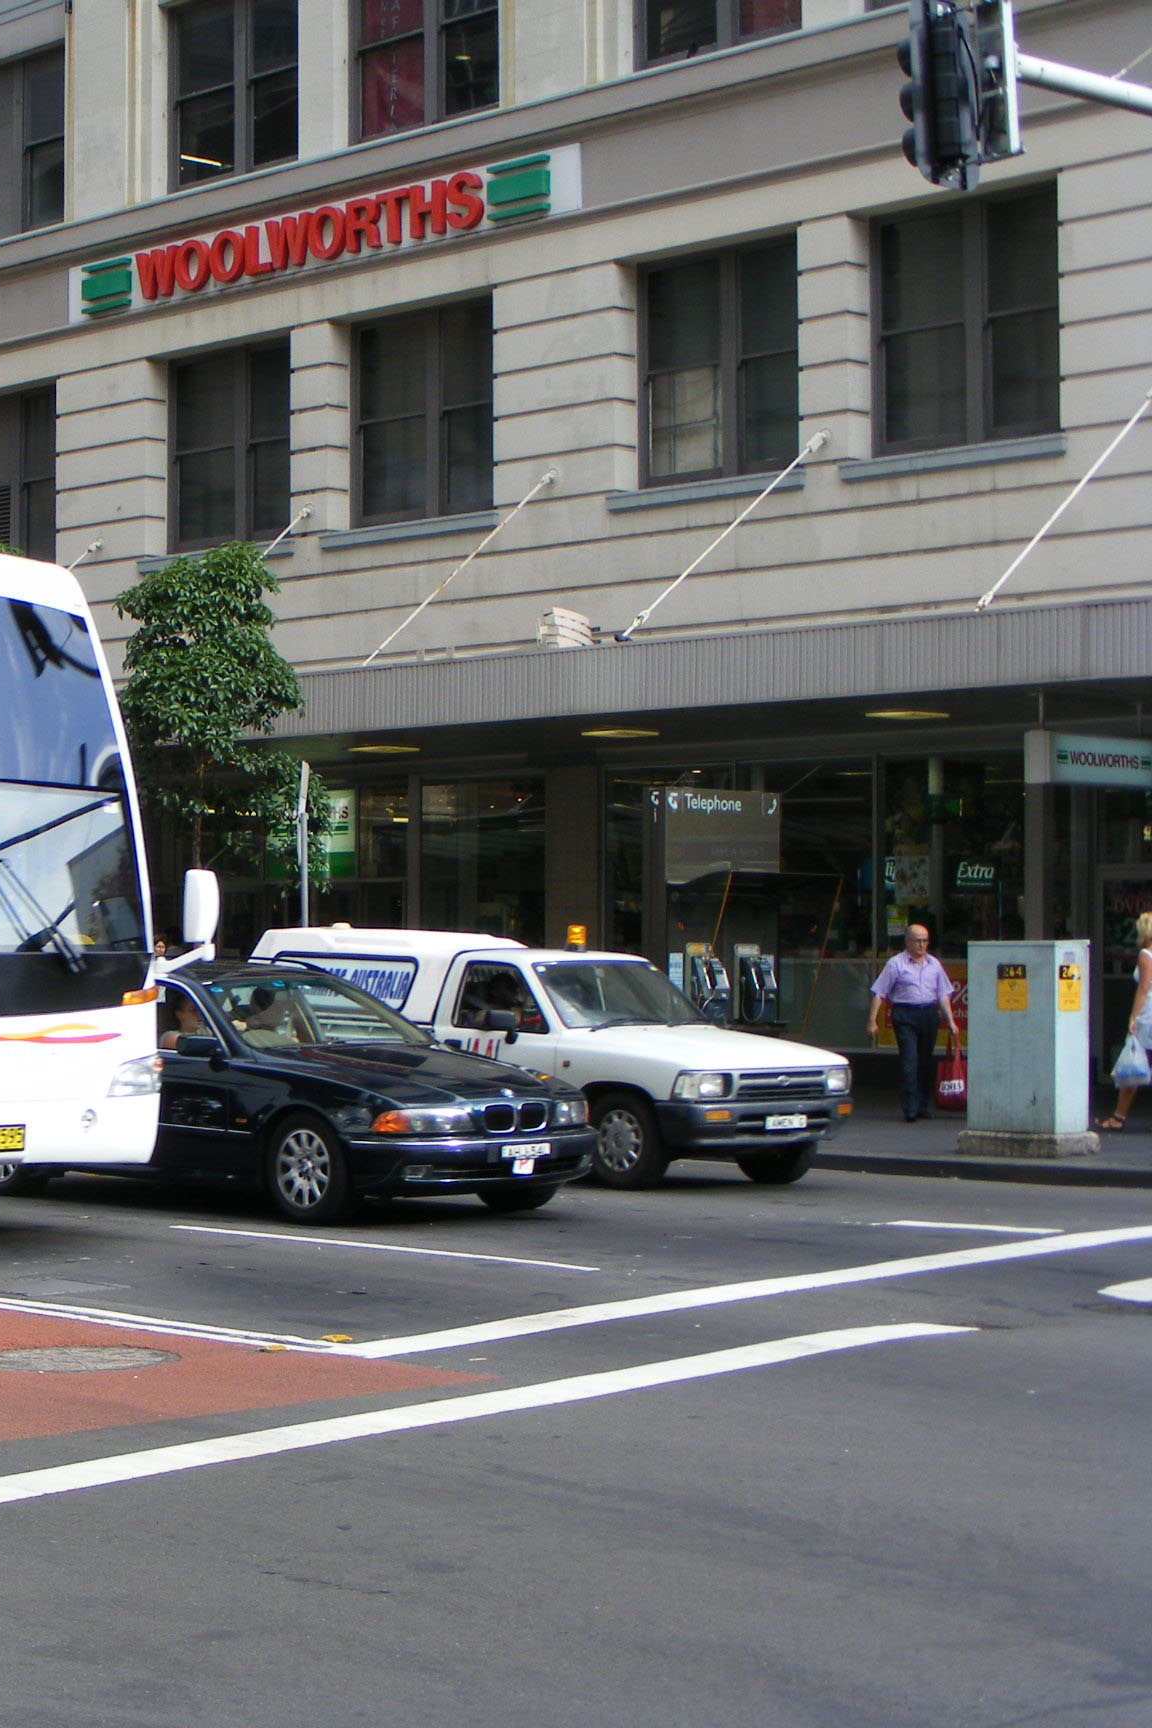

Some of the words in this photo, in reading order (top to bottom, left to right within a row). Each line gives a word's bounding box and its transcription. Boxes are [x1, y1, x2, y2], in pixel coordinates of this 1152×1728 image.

[136, 171, 484, 300] WOOLWORTHS
[1070, 750, 1140, 770] WOOLWORTHS
[685, 793, 742, 815] Telephone
[957, 861, 995, 879] Extra
[1002, 966, 1023, 977] 264
